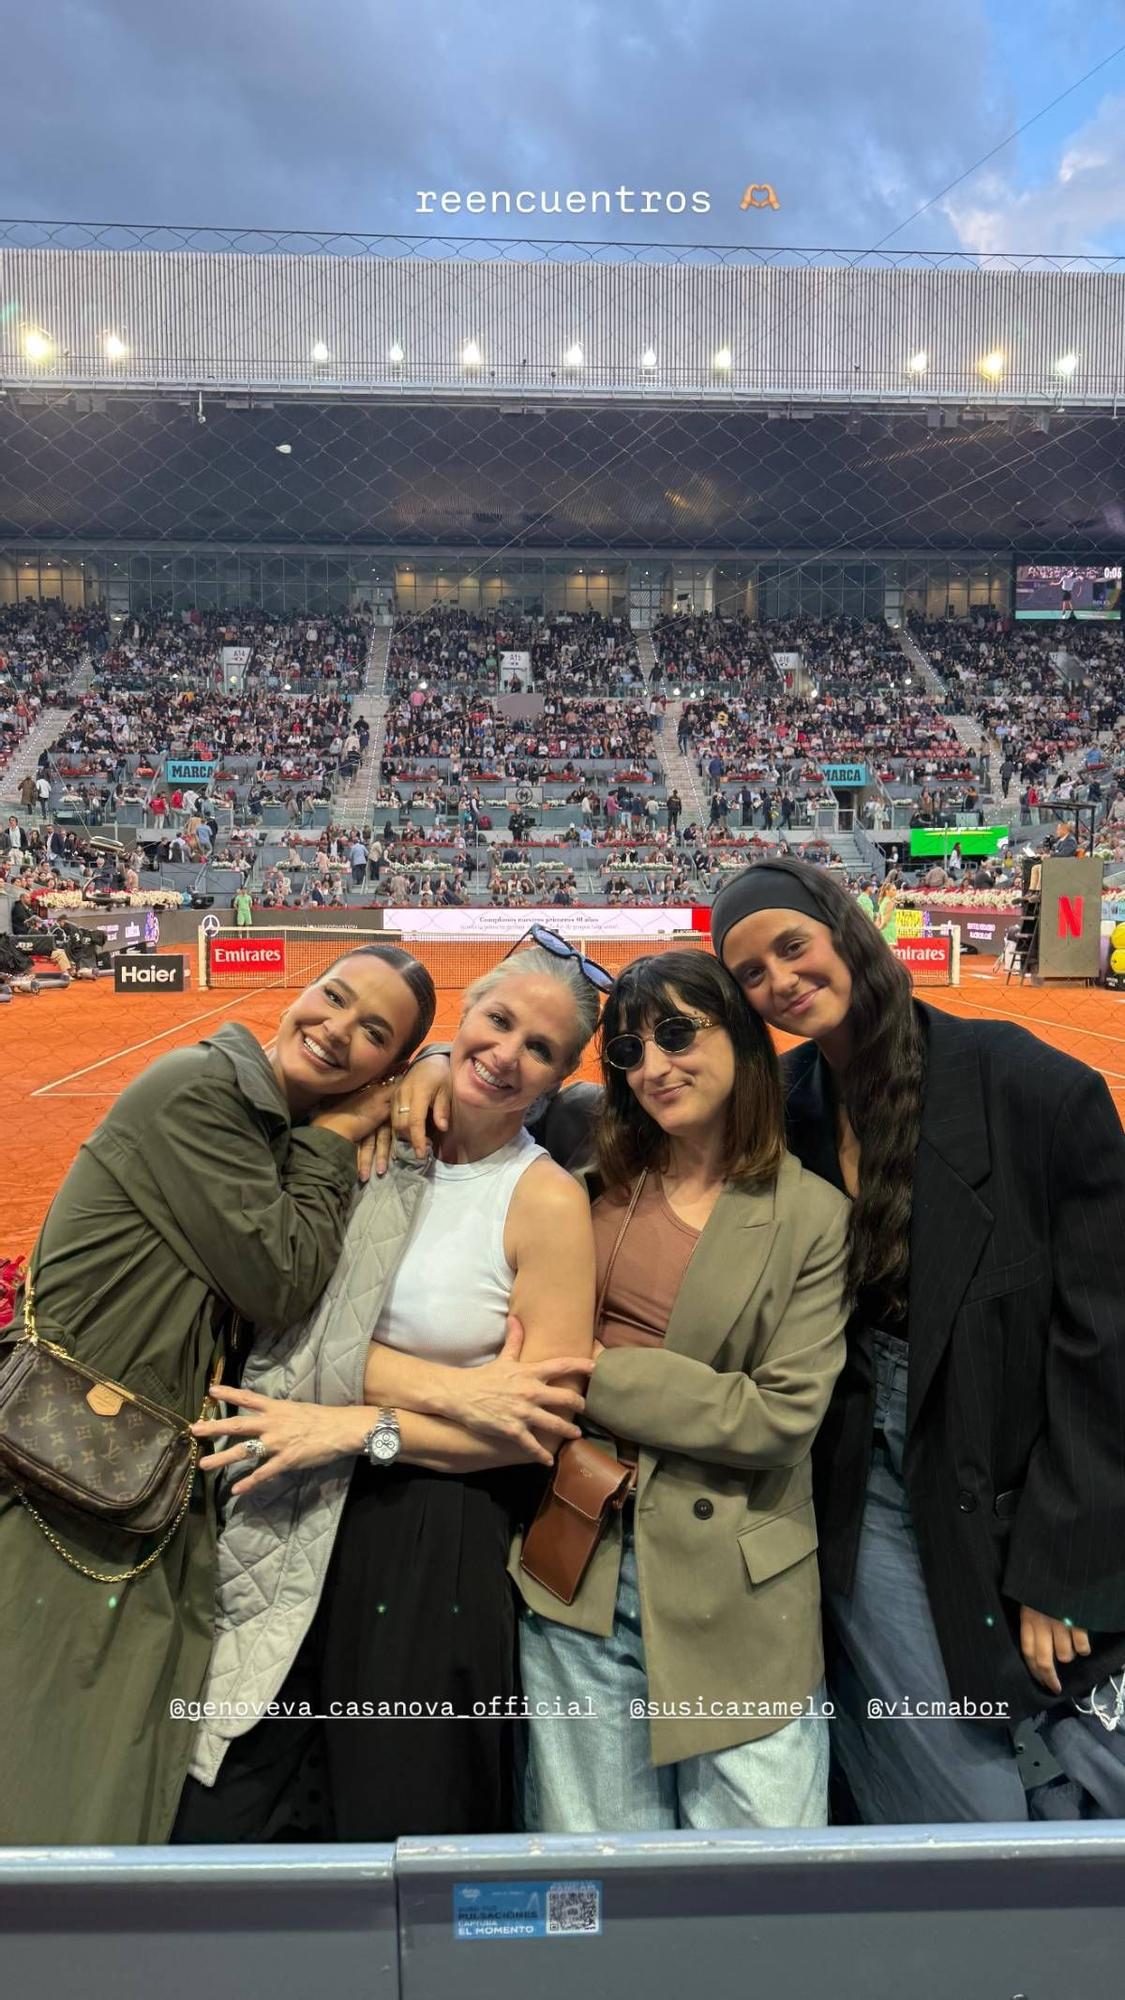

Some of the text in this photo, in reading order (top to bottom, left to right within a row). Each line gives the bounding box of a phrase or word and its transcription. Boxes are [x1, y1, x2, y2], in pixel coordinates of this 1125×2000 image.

[172, 765, 214, 778] MARCA
[823, 769, 861, 781] MARCA
[215, 948, 281, 963] Emirates
[895, 946, 946, 961] mirates
[121, 964, 177, 983] Haier
[458, 1925, 534, 1936] EL MOMENTO
